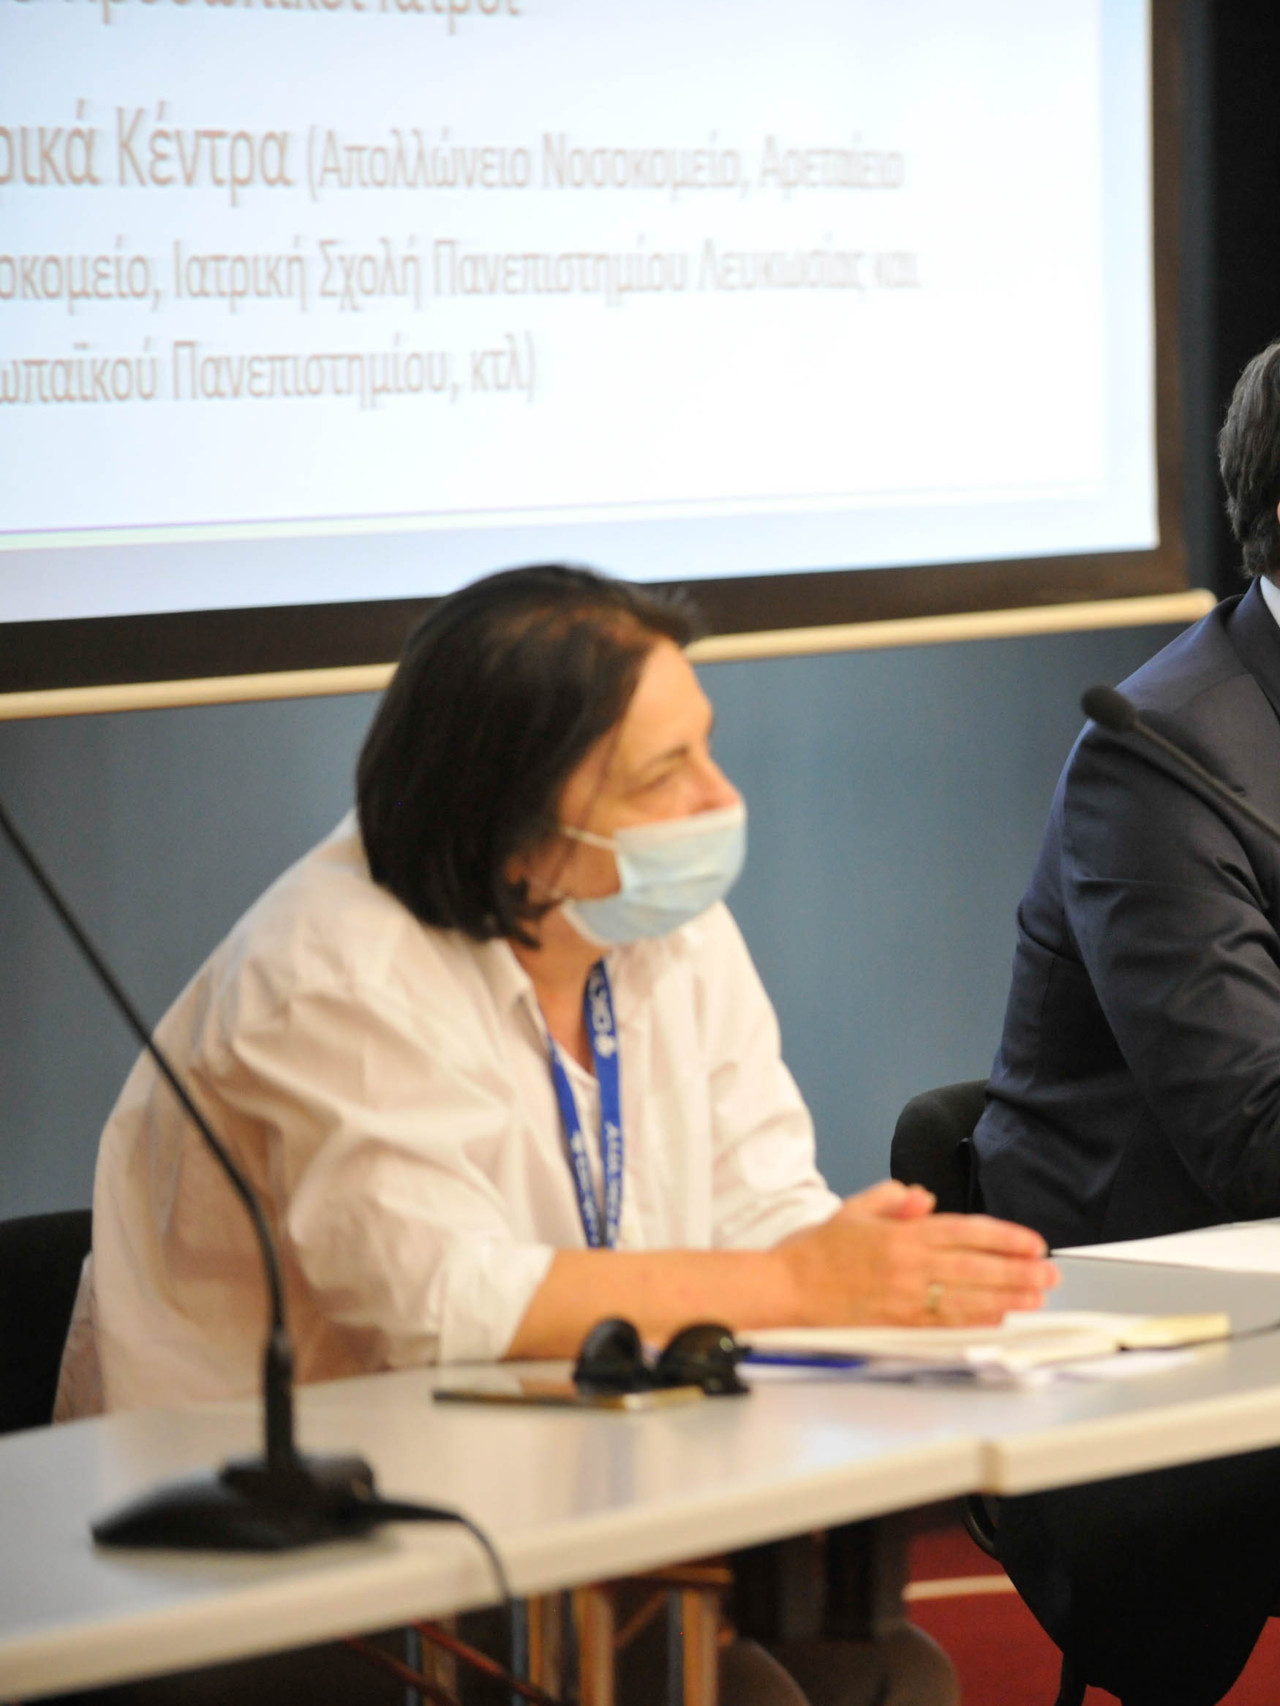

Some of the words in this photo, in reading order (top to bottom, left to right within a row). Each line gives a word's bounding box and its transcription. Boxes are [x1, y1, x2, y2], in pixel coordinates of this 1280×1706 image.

[116, 100, 295, 208] Κέντρα
[306, 124, 531, 202] (Απολλώνειο
[541, 130, 749, 200] Νοσοκομείο,
[172, 234, 306, 312] Ιατρική
[318, 235, 422, 312] Σχολή
[434, 232, 688, 308] Πανεπιστημίου
[172, 332, 459, 412] Πανεπιστημίου,
